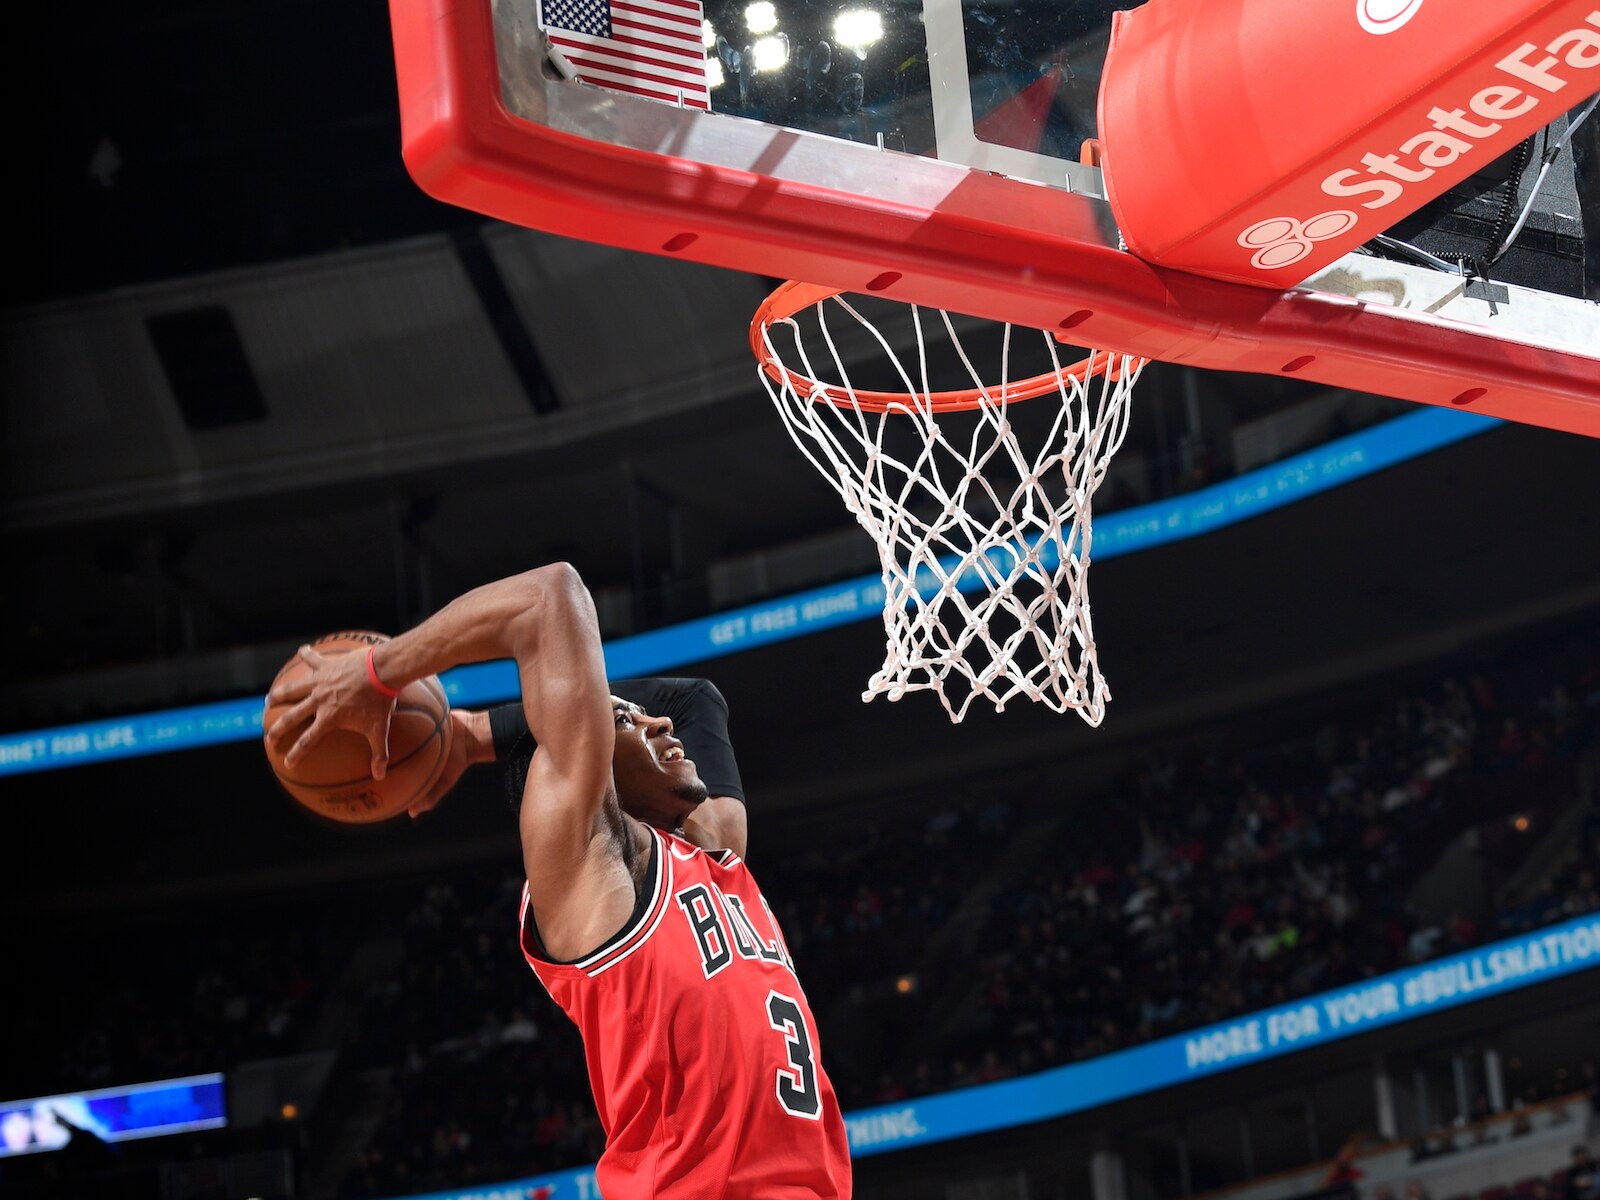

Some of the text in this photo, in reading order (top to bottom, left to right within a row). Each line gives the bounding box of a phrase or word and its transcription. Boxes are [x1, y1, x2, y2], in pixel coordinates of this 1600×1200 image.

[765, 989, 823, 1120] 3
[1185, 1019, 1263, 1070] MORE
[1266, 1004, 1320, 1047] FOR
[1324, 981, 1399, 1030] YOUR
